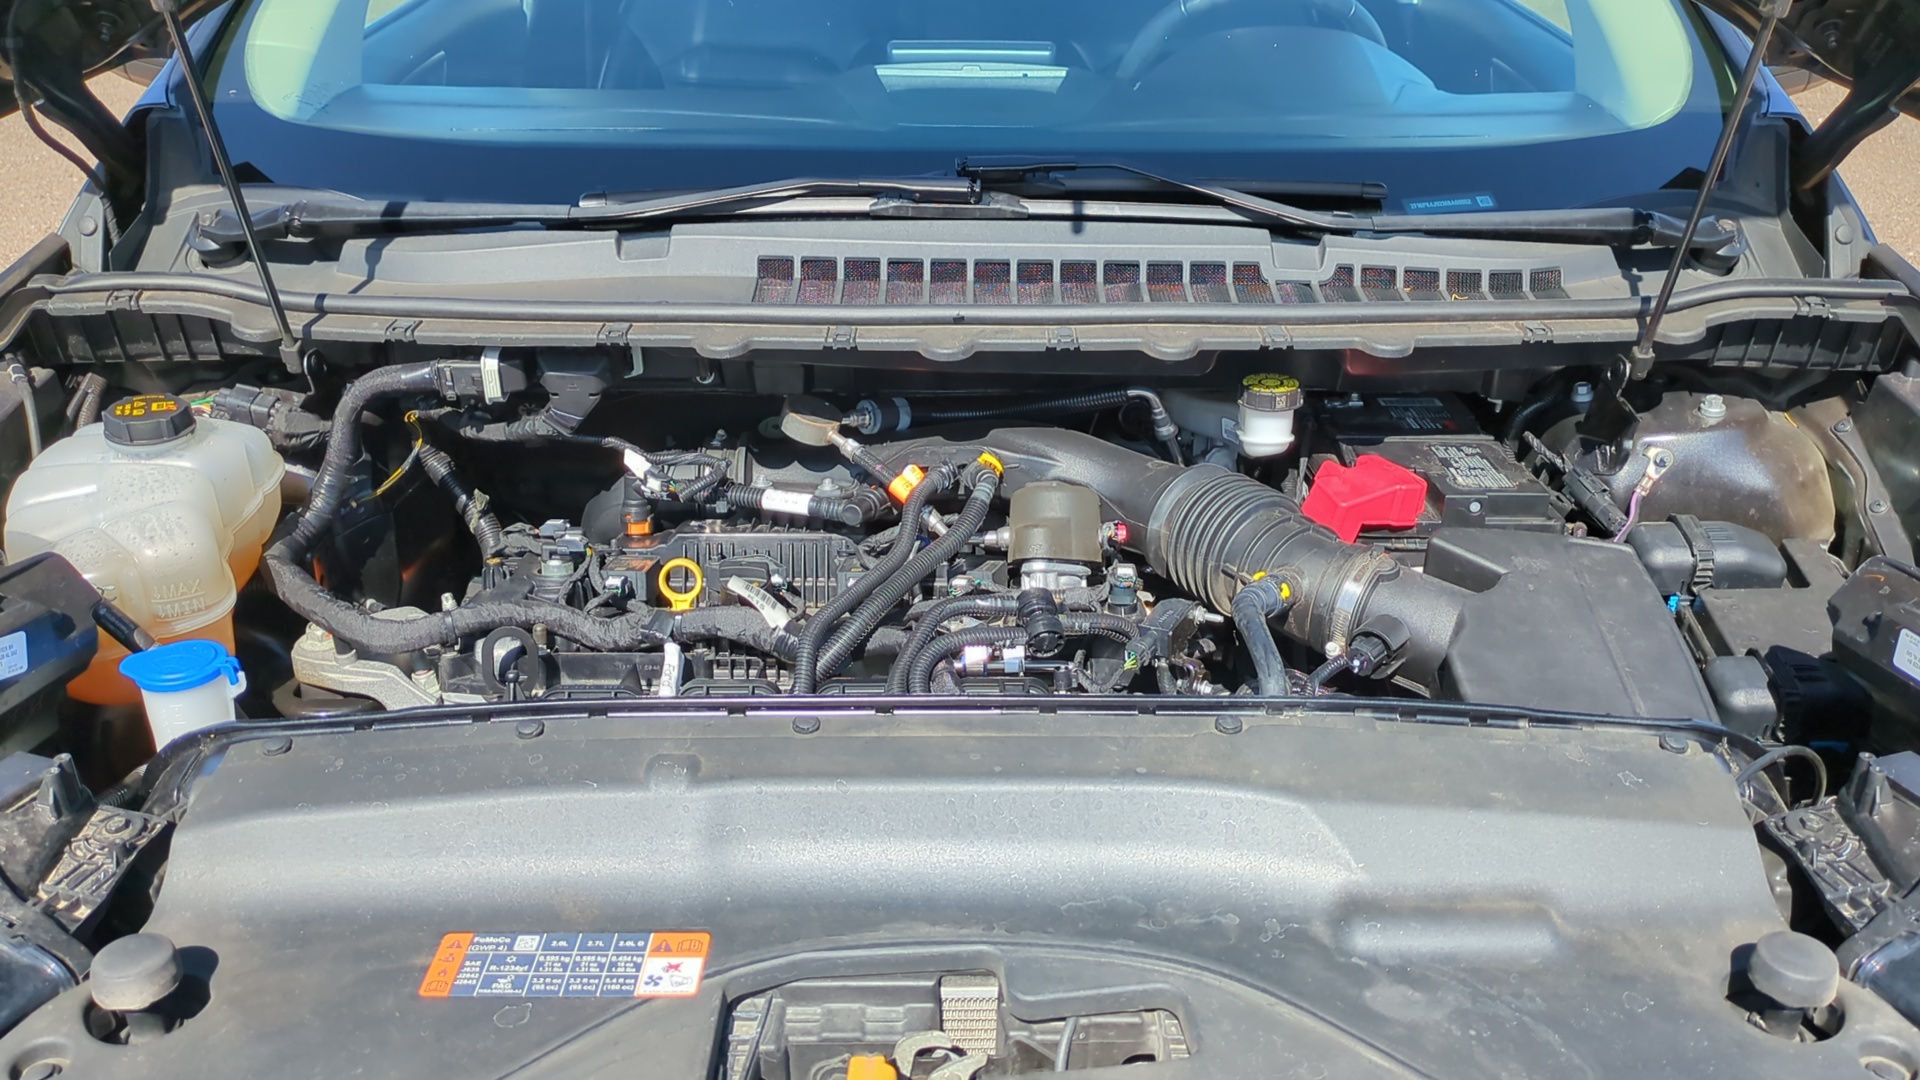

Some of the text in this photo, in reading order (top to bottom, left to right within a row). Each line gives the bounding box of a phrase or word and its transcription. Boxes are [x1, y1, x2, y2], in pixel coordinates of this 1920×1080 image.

[162, 578, 202, 599] MAX
[165, 597, 206, 618] MIN
[467, 944, 508, 952] (GWP 4)
[561, 955, 571, 963] kg
[597, 955, 607, 963] kg
[632, 955, 643, 963] kg
[489, 964, 529, 972] R-1234yf
[491, 982, 512, 990] PAG
